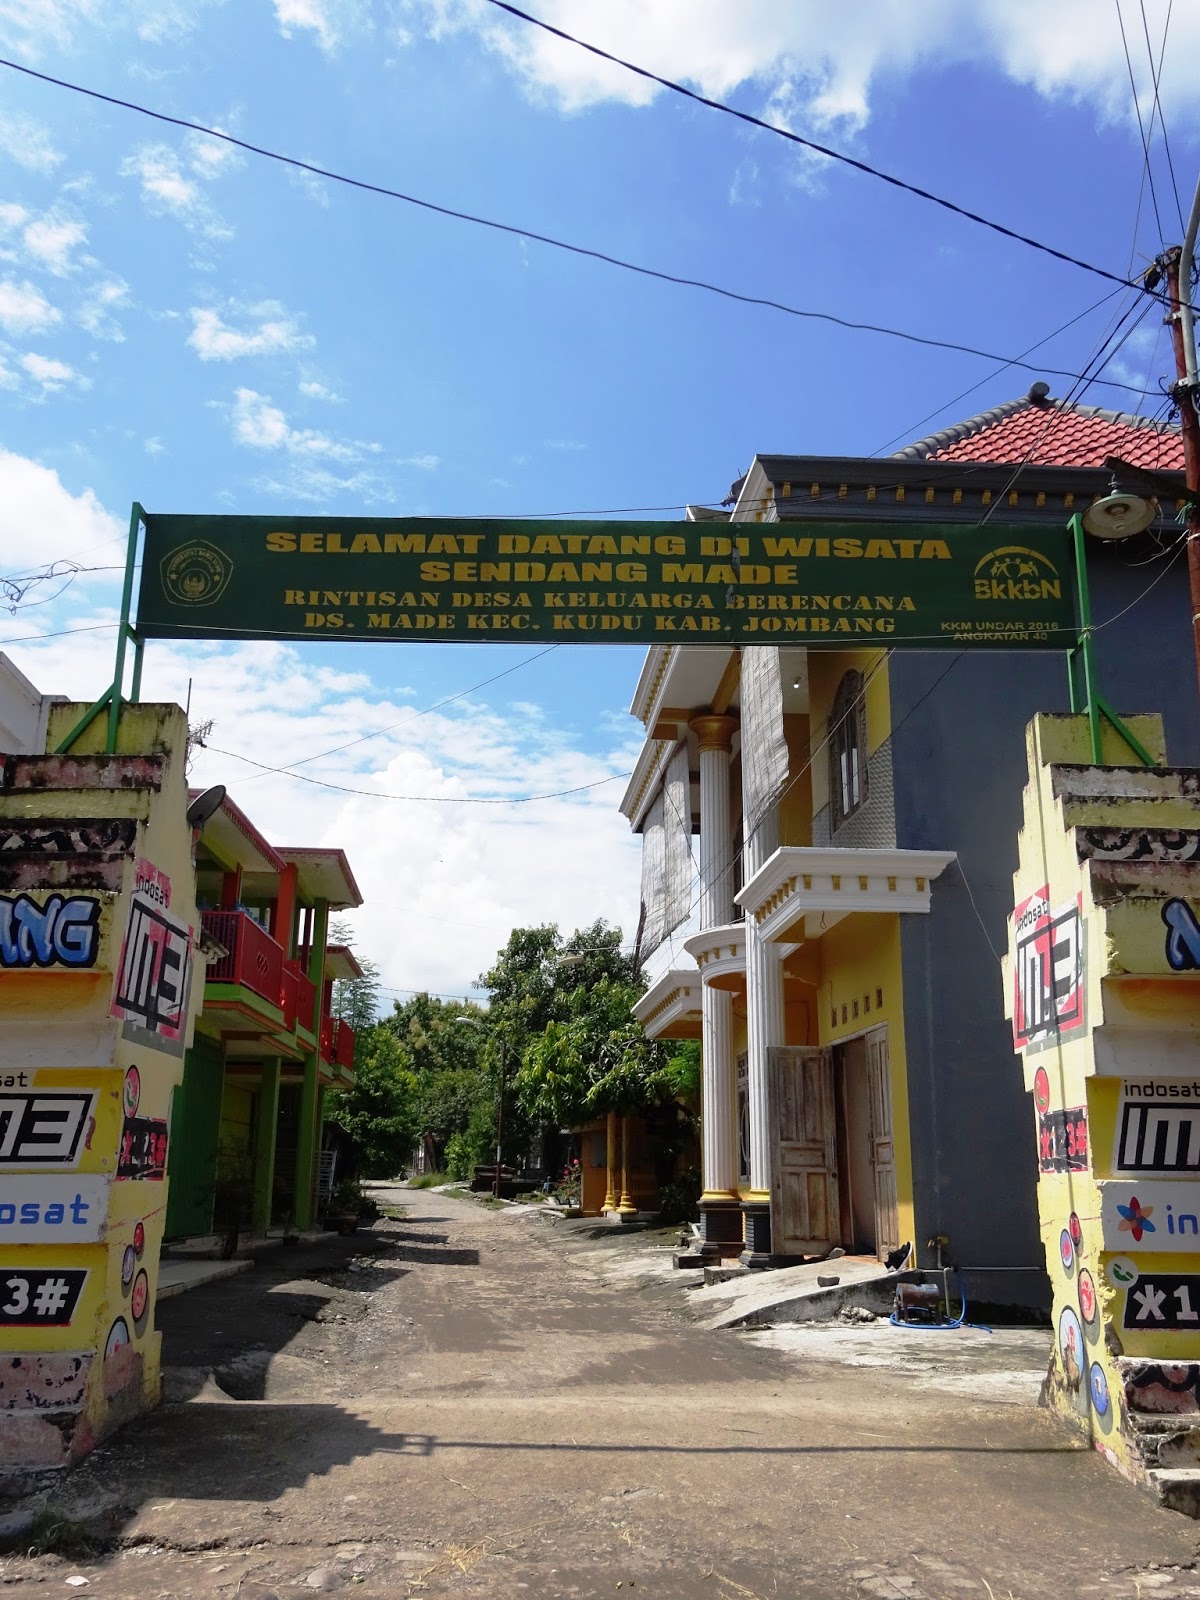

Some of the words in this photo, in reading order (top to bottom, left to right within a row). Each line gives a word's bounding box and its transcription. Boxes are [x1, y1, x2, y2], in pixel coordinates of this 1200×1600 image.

[266, 532, 486, 554] SELAMAT
[498, 534, 686, 556] DATANG
[700, 536, 750, 557] DI
[762, 537, 952, 559] WISATA
[420, 561, 648, 582] SENDANG
[662, 563, 799, 585] MADE
[284, 589, 441, 607] RINTISAN
[452, 592, 533, 608] DESA
[544, 592, 715, 609] KELUARGA
[725, 594, 917, 611] BERENCANA
[304, 612, 355, 629] DS.
[367, 613, 456, 629] MADE
[467, 614, 540, 630] KEC.
[552, 614, 643, 630] KUDU
[655, 615, 732, 632] KAB.
[742, 616, 896, 633] JOMBANG
[941, 622, 972, 631] KKM
[976, 622, 1025, 631] UNDAR
[953, 632, 1029, 641] ANGKATAN
[0, 1072, 28, 1087] at
[1124, 1079, 1200, 1097] indosat
